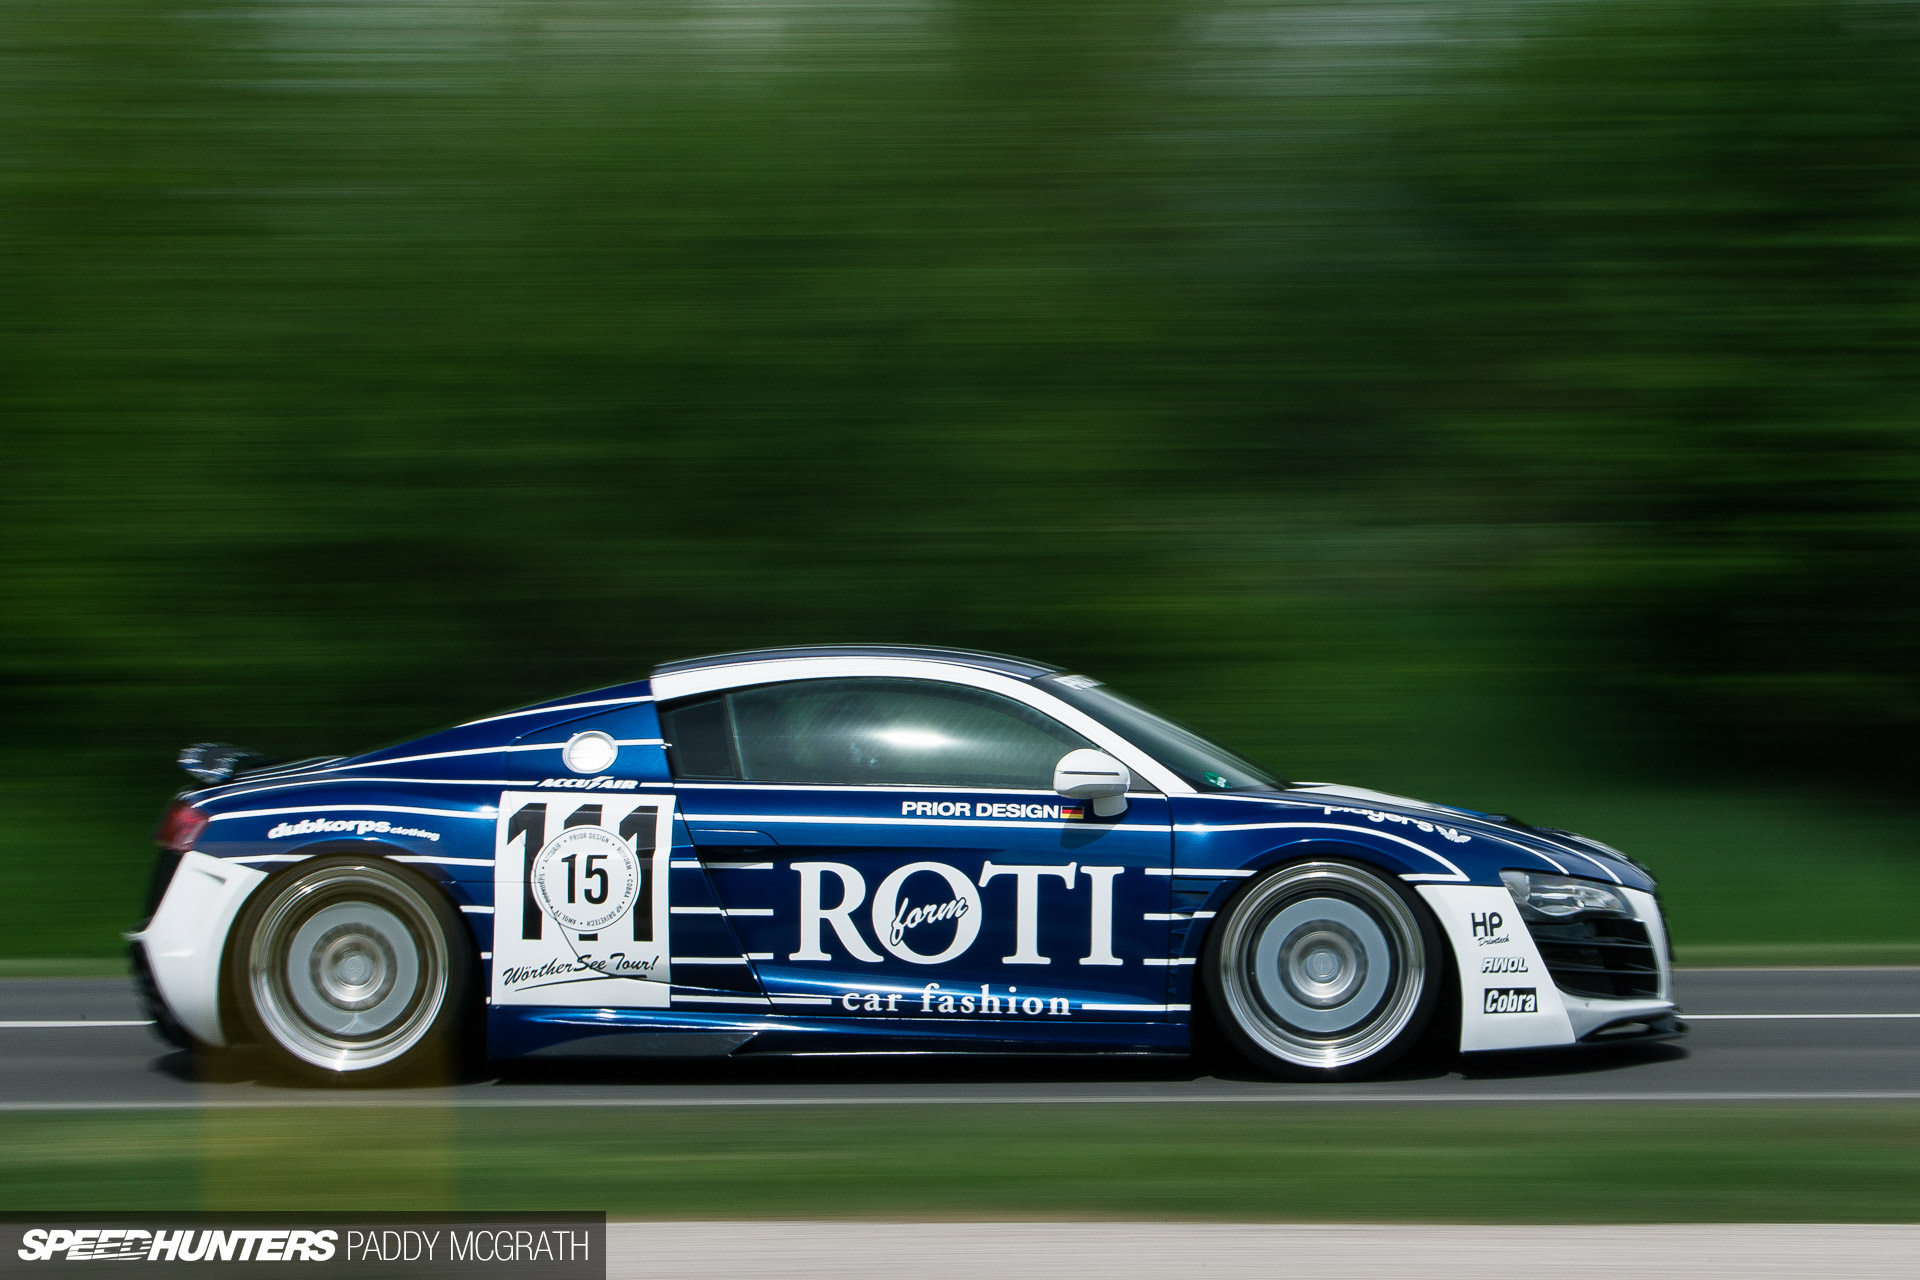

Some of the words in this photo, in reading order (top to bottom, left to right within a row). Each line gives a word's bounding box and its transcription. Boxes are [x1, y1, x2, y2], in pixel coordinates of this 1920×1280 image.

[902, 801, 971, 817] PRIOR
[975, 803, 1059, 819] DESIGN
[1324, 805, 1435, 833] payers
[267, 818, 391, 840] dubkorps
[389, 826, 441, 842] clothing
[561, 853, 609, 905] 15
[889, 895, 970, 947] form
[1471, 911, 1503, 937] HP
[610, 952, 660, 971] Tour!
[1482, 957, 1528, 973] AWOL
[841, 991, 903, 1013] car
[920, 982, 1073, 1016] fashion
[1485, 989, 1536, 1013] Cobra
